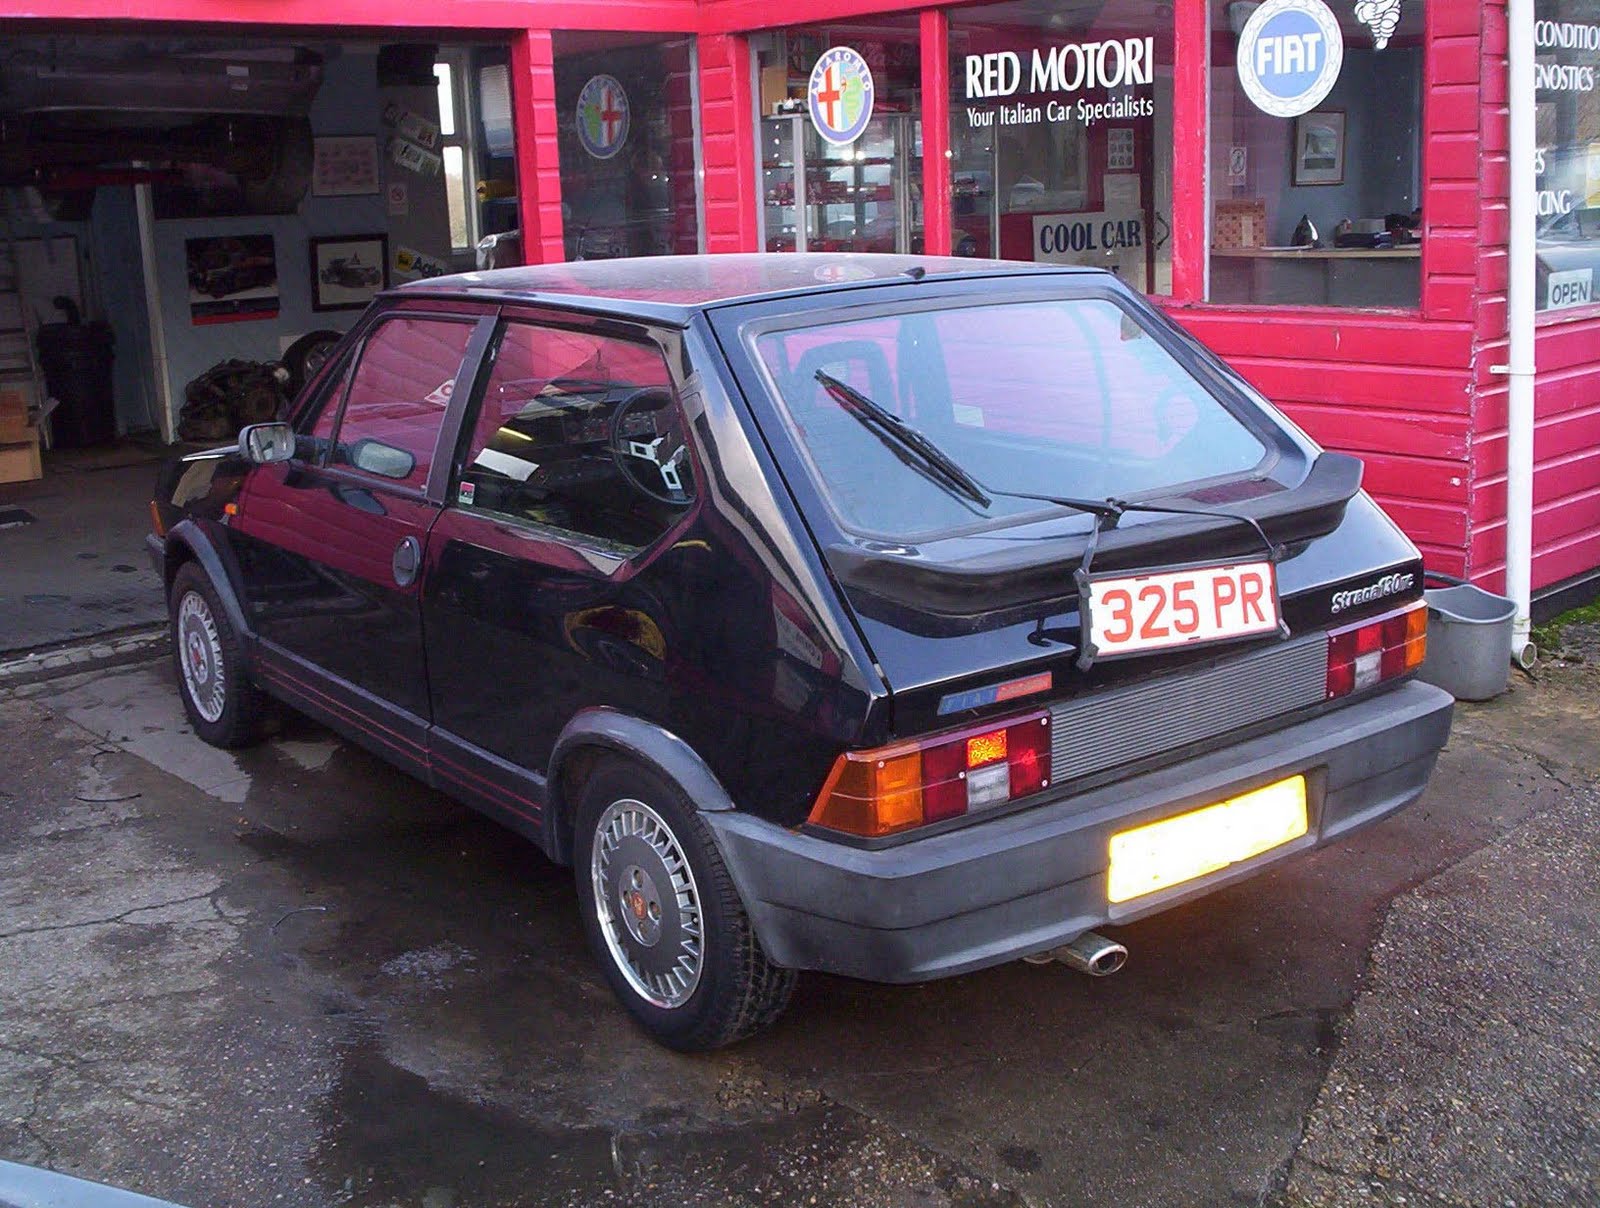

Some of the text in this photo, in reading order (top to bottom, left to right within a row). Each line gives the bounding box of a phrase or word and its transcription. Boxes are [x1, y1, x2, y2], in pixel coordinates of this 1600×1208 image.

[1535, 20, 1600, 50] CONDITIO
[966, 37, 1154, 98] RED MOTORI
[1257, 32, 1321, 76] FIAT
[967, 94, 1154, 127] Your Italian Car Specialists
[1040, 219, 1141, 254] COOL CAR
[1552, 281, 1588, 305] OPEN
[1101, 572, 1266, 643] 325 PR
